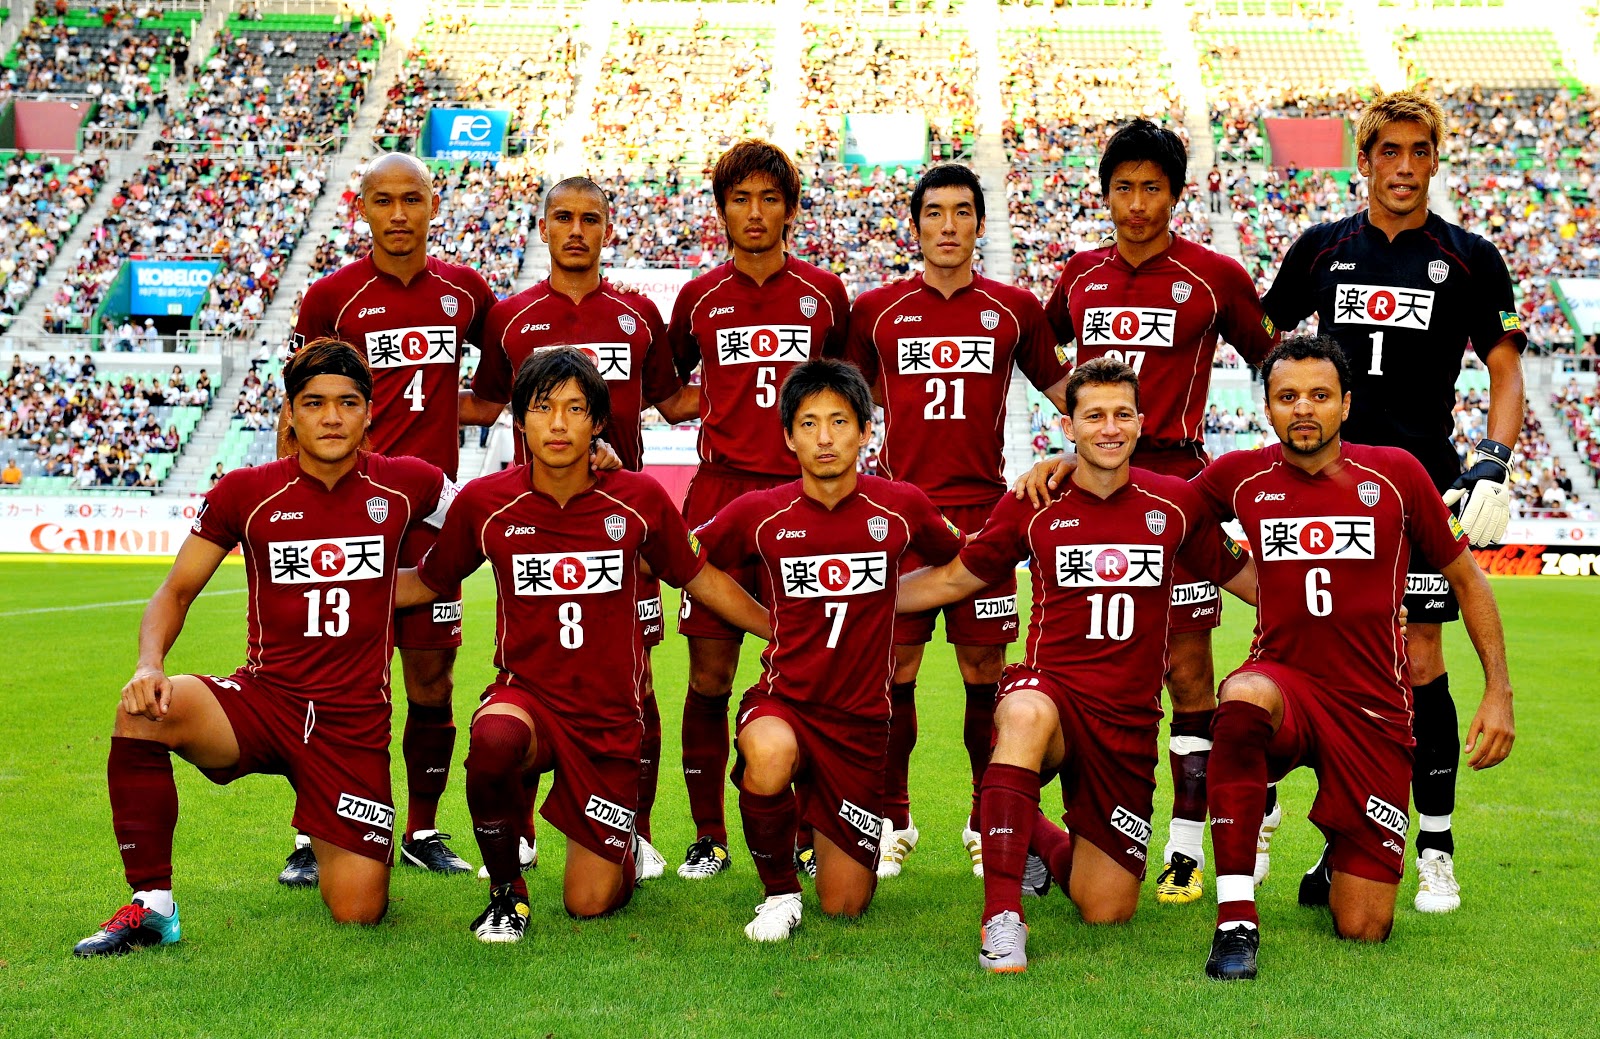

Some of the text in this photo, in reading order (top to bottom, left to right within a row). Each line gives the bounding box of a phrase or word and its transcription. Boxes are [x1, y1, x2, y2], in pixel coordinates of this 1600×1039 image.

[138, 267, 213, 287] KOBELCO
[629, 282, 680, 293] TACHI
[1337, 288, 1431, 326] 楽R天
[720, 329, 808, 361] 楽R天
[1084, 310, 1174, 343] 楽R天
[370, 330, 455, 365] 楽R天
[901, 340, 991, 371] 楽R天
[1367, 331, 1384, 375] 1
[403, 369, 425, 411] 4
[755, 366, 776, 408] 5
[923, 378, 967, 420] 21
[169, 505, 196, 519] 楽R
[30, 522, 169, 552] Canon
[1264, 521, 1372, 557] 楽R天
[273, 540, 381, 580] 楽R天
[516, 554, 621, 592] 楽R天
[784, 556, 884, 594] 楽R天
[1059, 549, 1161, 583] 楽R天
[976, 598, 1017, 616] スカルプ
[1172, 583, 1217, 602] カルプロ
[1305, 567, 1333, 617] 6
[303, 587, 351, 637] 13
[558, 602, 584, 649] 8
[824, 602, 849, 648] 7
[1085, 592, 1135, 641] 10
[1112, 808, 1153, 841] スカルプ
